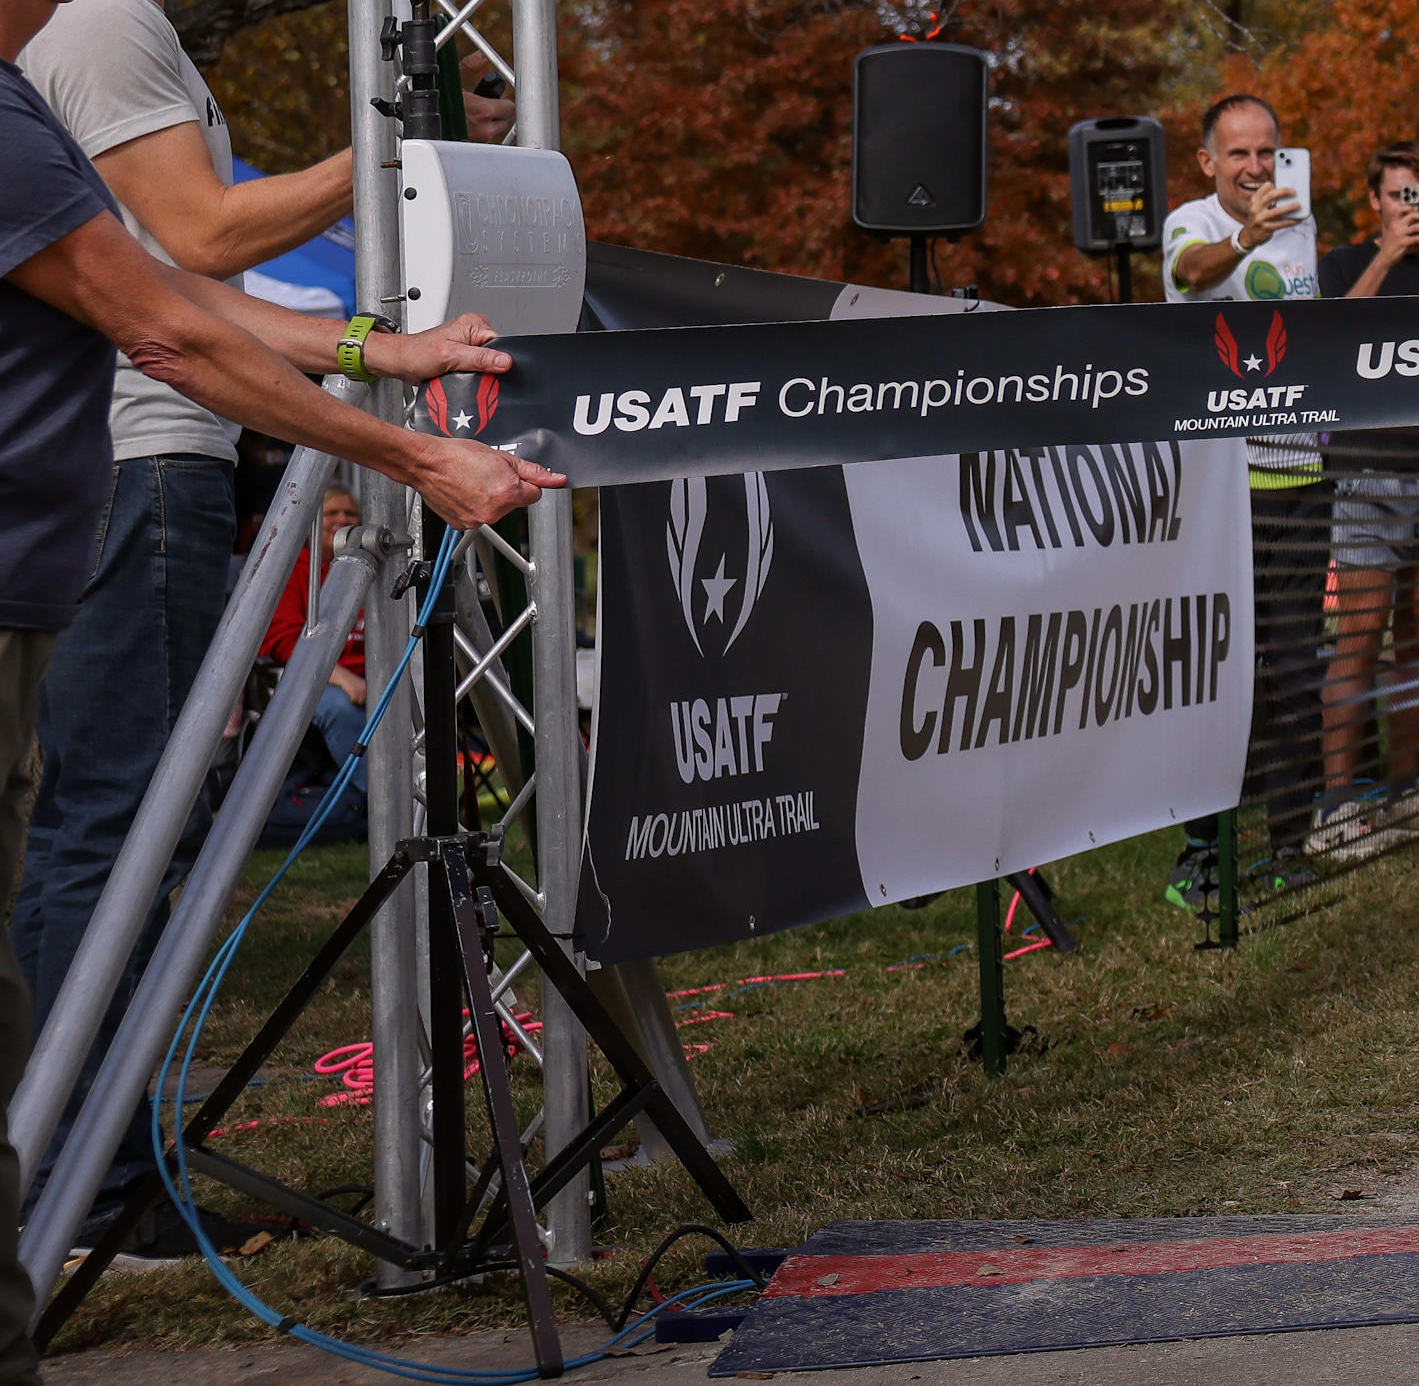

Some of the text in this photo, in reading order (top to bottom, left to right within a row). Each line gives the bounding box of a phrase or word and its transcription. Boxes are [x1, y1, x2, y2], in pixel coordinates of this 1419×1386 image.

[572, 363, 1150, 436] USATF Championships
[1174, 409, 1340, 432] MOUNTAIN ULTRA TRAIL
[1207, 385, 1305, 413] USATF
[958, 441, 1183, 553] NATIONAL
[898, 592, 1232, 762] CHAMPIONSHIP
[670, 692, 783, 784] USATF
[625, 791, 820, 861] MOUNTAIN ULTRA TRAIL
